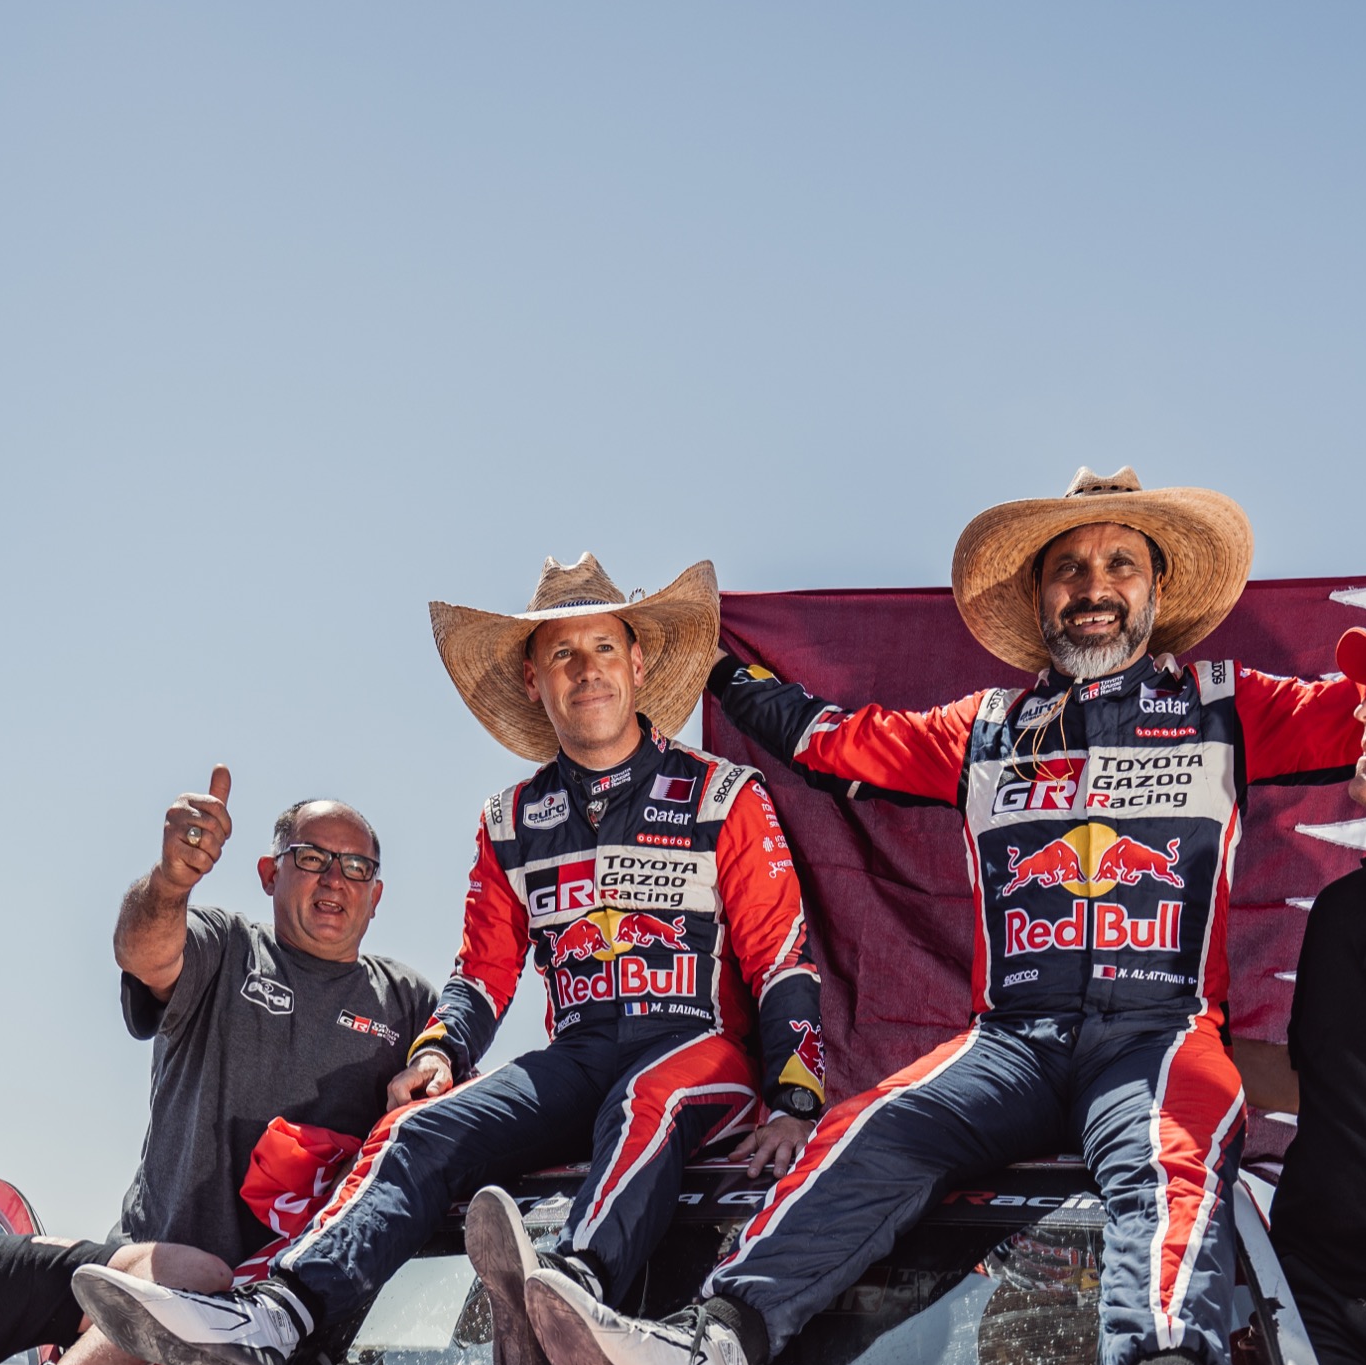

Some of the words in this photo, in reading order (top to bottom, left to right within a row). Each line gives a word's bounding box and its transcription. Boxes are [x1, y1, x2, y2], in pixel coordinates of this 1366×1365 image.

[1081, 687, 1100, 700] GR
[1139, 698, 1190, 716] Qatar
[1135, 726, 1197, 738] ooredoo
[1098, 753, 1203, 773] TOYOTA
[592, 781, 610, 795] GR
[713, 765, 745, 804] sparco
[1092, 773, 1193, 791] GAZOO
[993, 780, 1077, 815] GR
[1087, 790, 1188, 808] Racing
[527, 796, 568, 821] eurol
[643, 806, 692, 826] Qatar
[637, 833, 692, 847] ooredoo
[603, 855, 698, 874] TOYOTA
[601, 872, 687, 888] GAZOO
[529, 879, 595, 916] GR
[600, 888, 684, 907] Racing
[1004, 899, 1089, 957] Red
[1093, 900, 1184, 952] Bull
[555, 959, 616, 1009] Red
[619, 953, 697, 997] Bull
[1003, 969, 1039, 988] sparco
[1117, 968, 1129, 979] N.
[650, 1002, 664, 1013] M.
[668, 1003, 712, 1019] BAUMEL
[339, 1016, 368, 1033] GR
[557, 1011, 581, 1032] sparco
